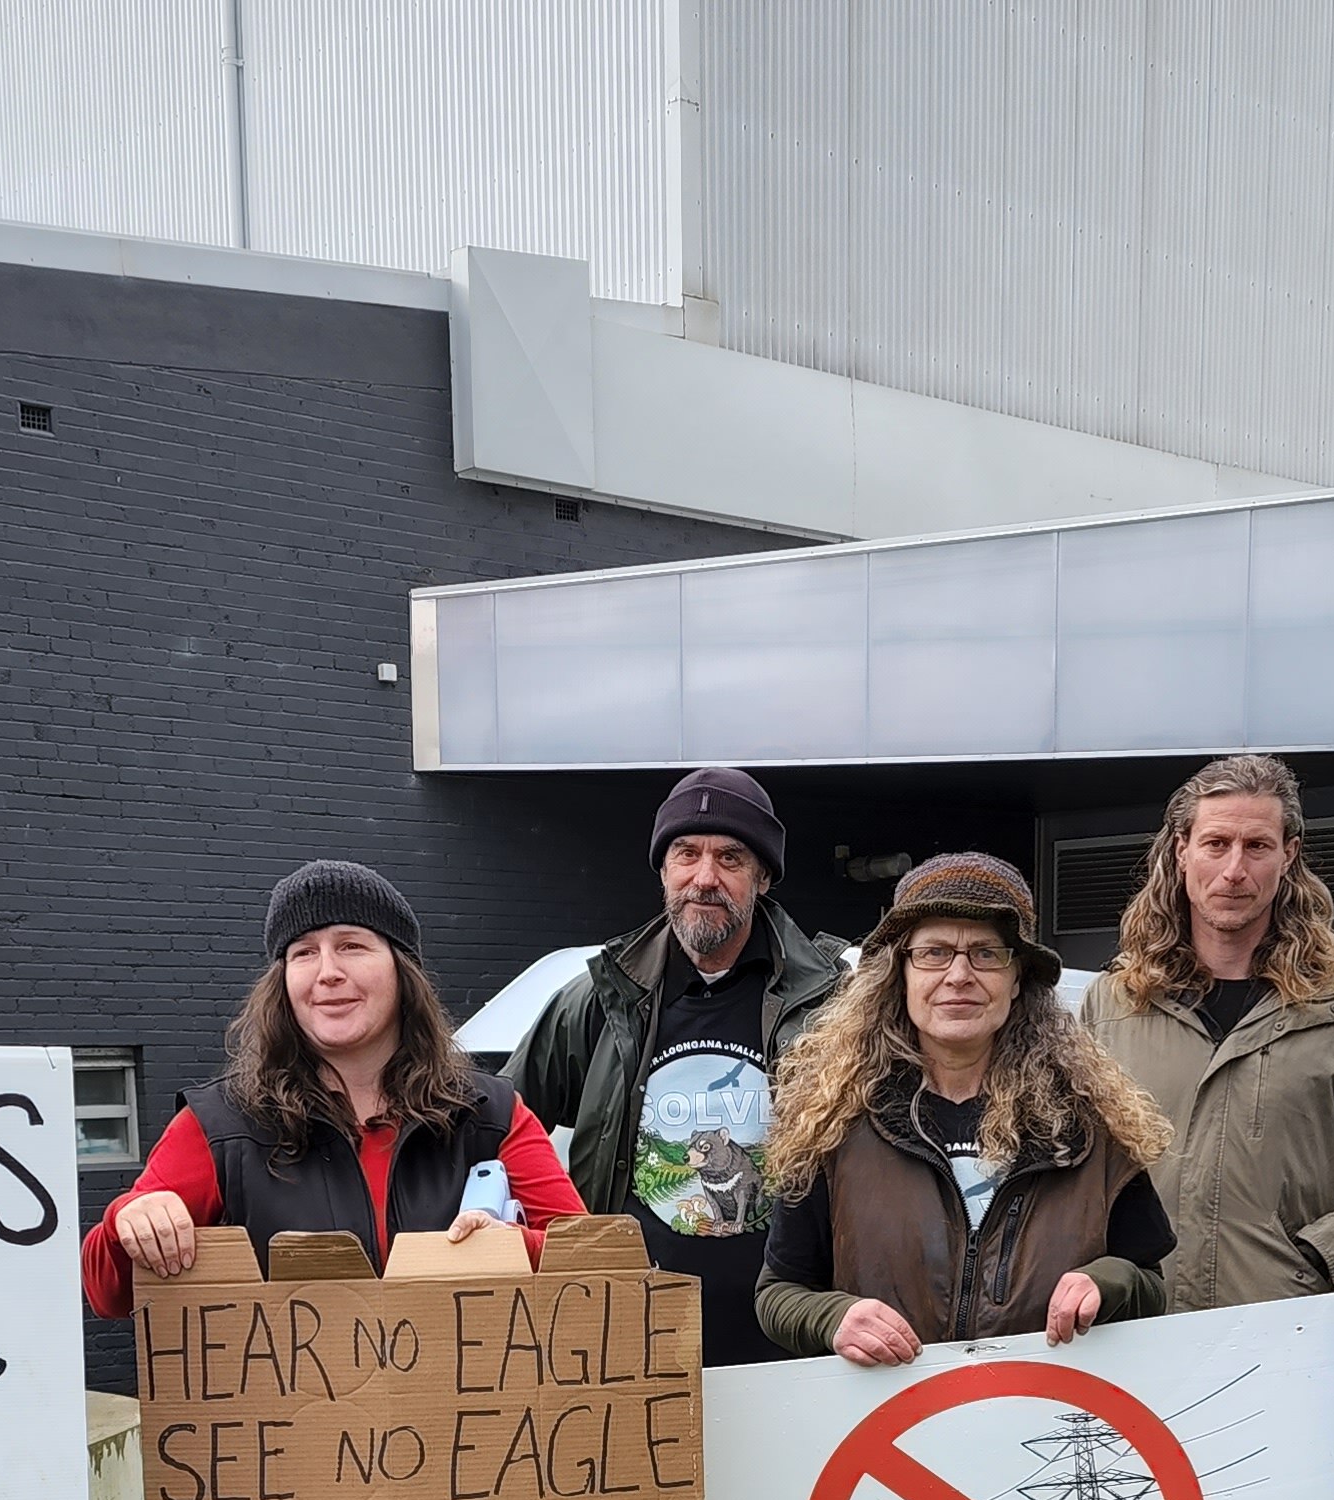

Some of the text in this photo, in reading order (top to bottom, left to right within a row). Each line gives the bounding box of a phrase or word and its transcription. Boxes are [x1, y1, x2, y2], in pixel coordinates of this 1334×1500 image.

[143, 1281, 693, 1402] HEAR NO EAGLE
[334, 1425, 426, 1485] NO
